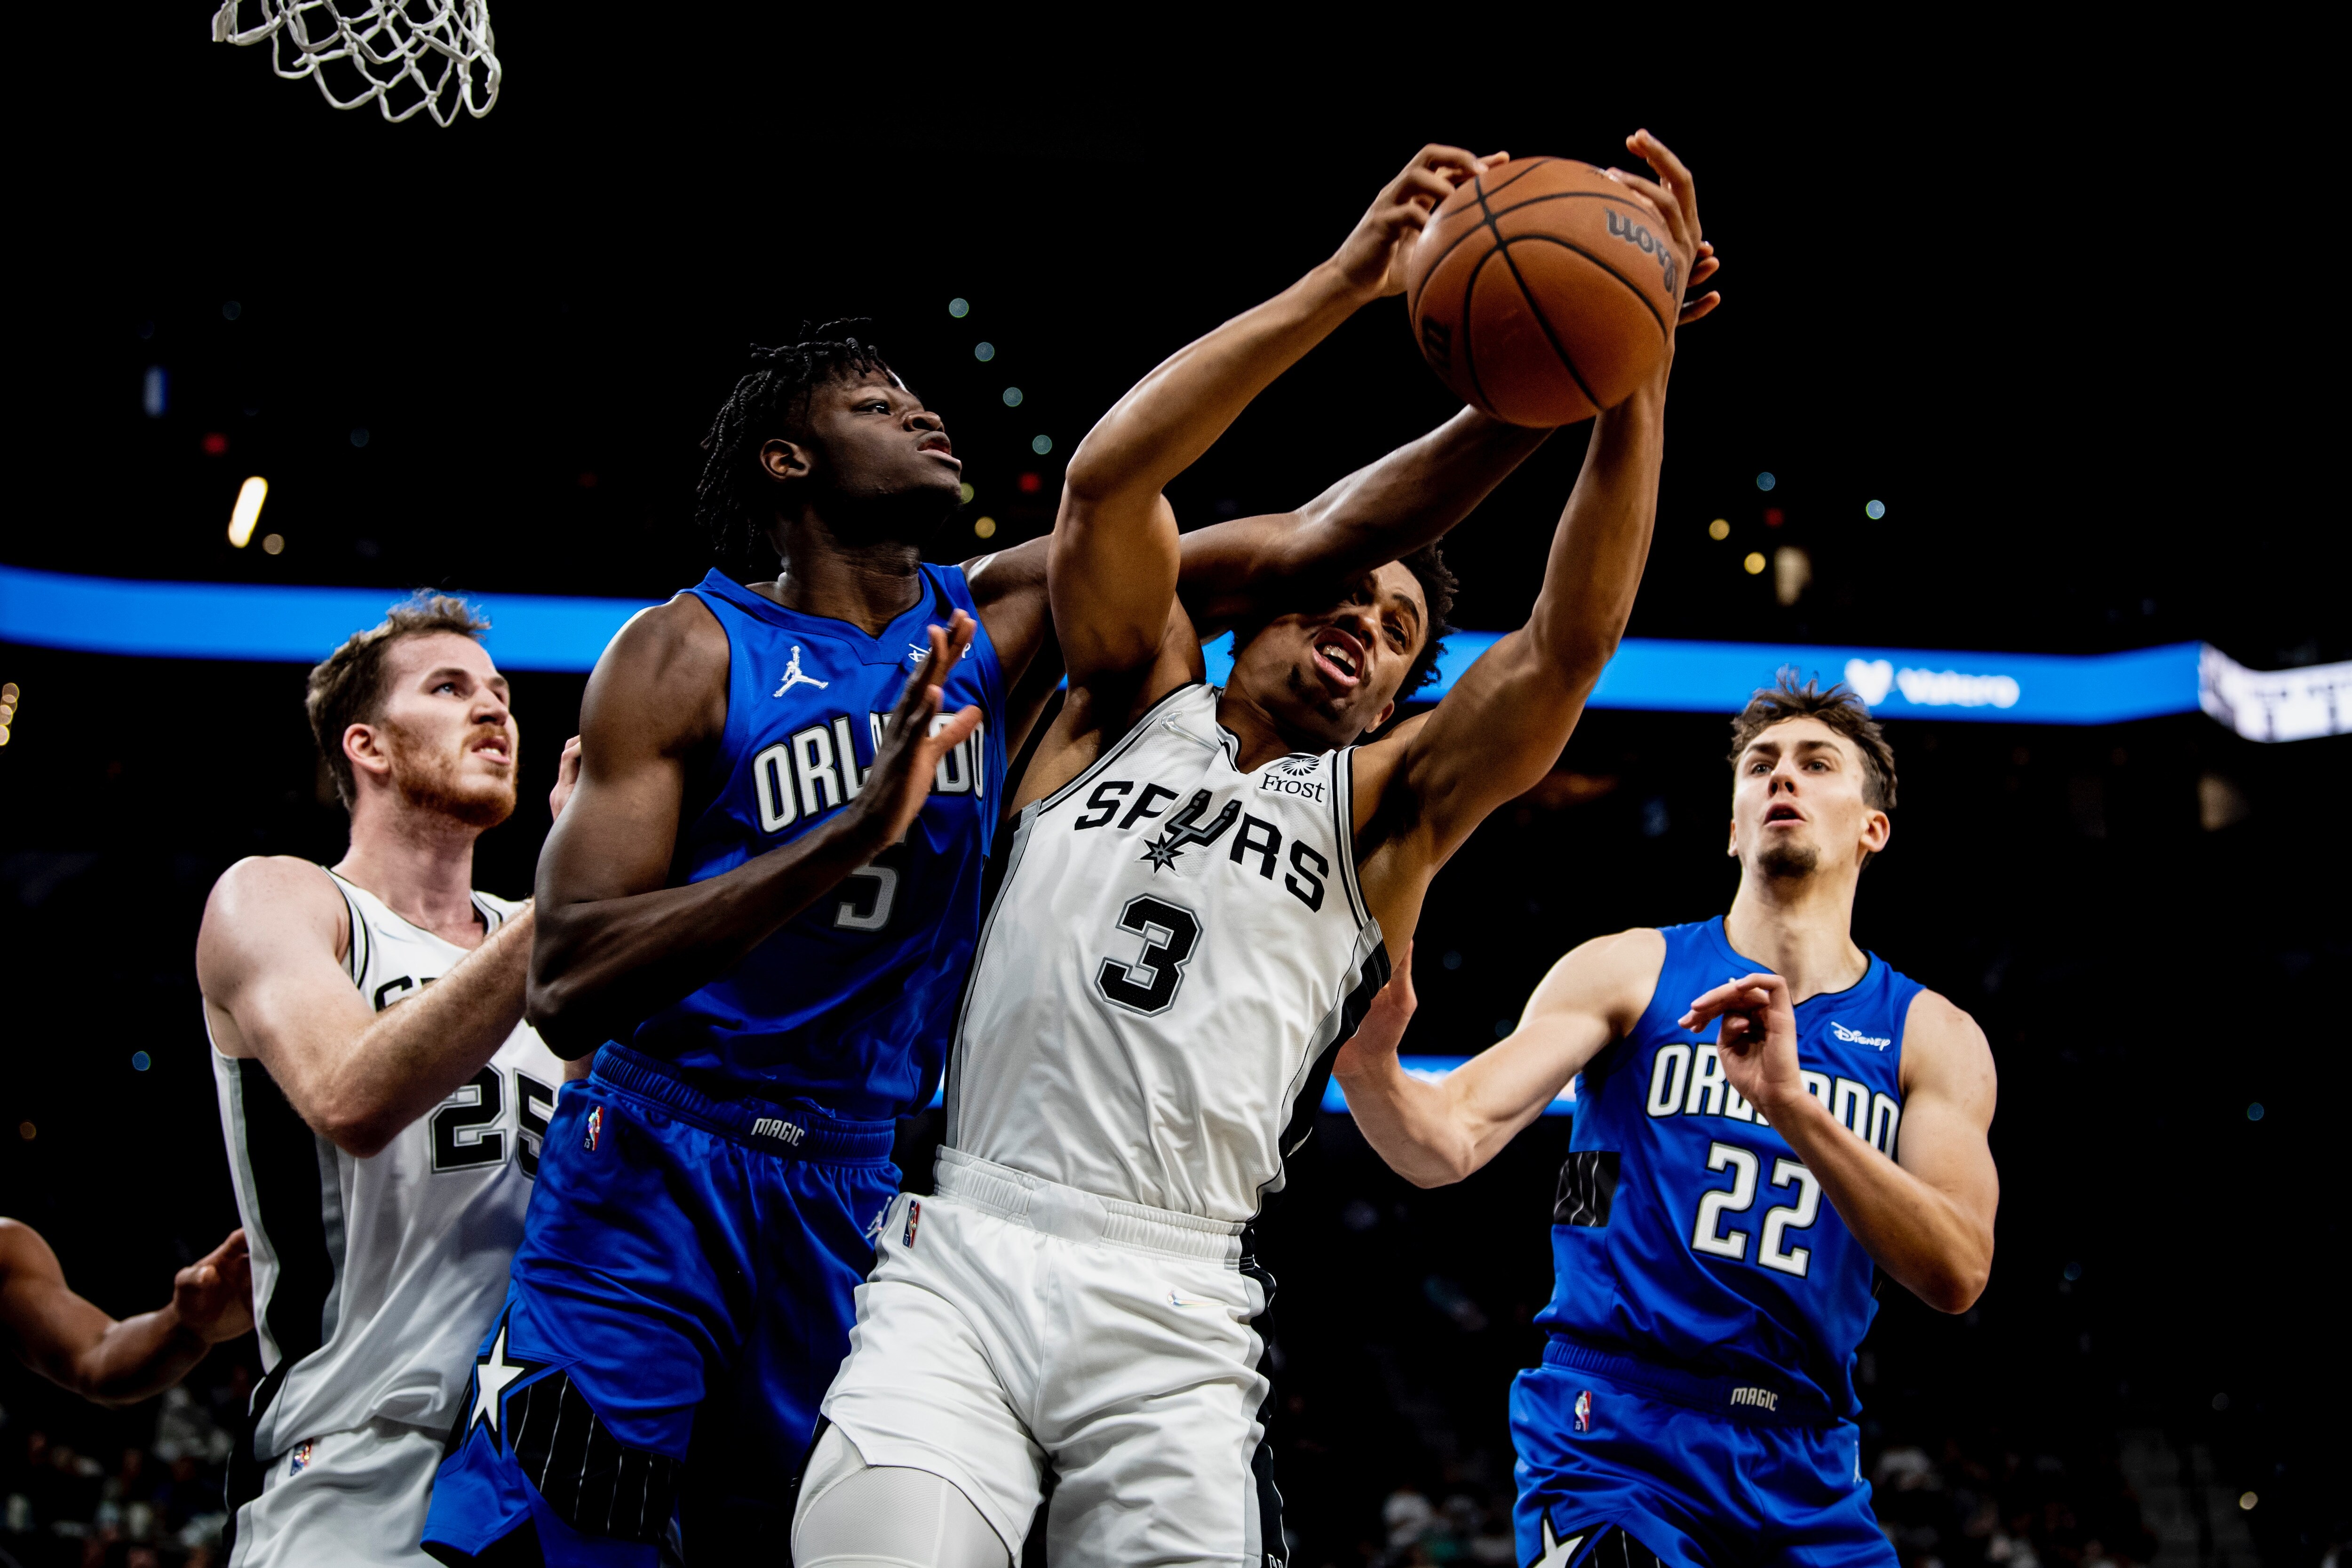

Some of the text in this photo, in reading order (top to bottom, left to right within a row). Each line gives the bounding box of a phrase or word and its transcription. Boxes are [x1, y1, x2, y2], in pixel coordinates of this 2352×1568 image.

[1259, 773, 1326, 803] Frost
[1094, 892, 1203, 1018] 3
[429, 1062, 557, 1181] 25
[751, 1117, 805, 1147] MAGIC
[1692, 1141, 1822, 1278] 22
[1731, 1386, 1778, 1412] MAGIC
